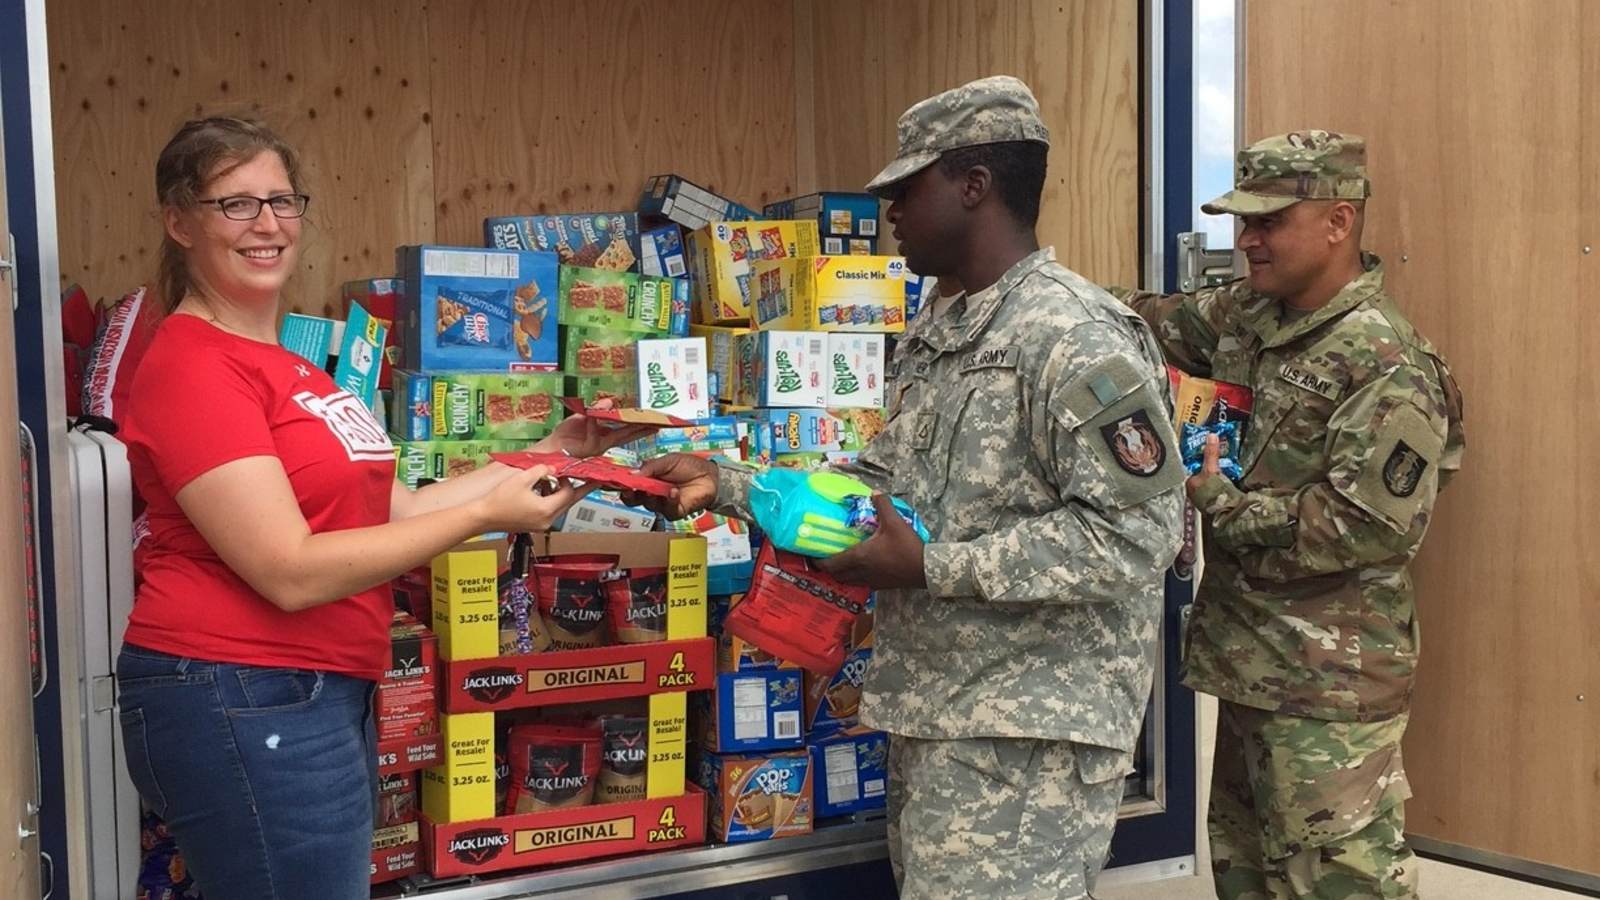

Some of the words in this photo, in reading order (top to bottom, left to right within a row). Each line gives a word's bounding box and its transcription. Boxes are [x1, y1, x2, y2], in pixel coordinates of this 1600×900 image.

[889, 262, 902, 270] 40
[836, 270, 868, 280] Classic
[870, 271, 886, 280] Mix
[458, 291, 508, 319] TRADITIONAL
[641, 281, 657, 327] CRUNCHY
[1300, 374, 1333, 394] ARMY
[452, 383, 469, 434] CRUNCHY
[673, 571, 698, 579] Resale!
[457, 578, 480, 586] Great
[461, 585, 492, 594] Resale!
[670, 599, 688, 608] 3.25
[459, 614, 479, 624] 3.25
[481, 614, 497, 622] oz.
[626, 605, 654, 622] JACK
[669, 652, 685, 672] 4
[384, 669, 403, 678] JACK
[544, 667, 629, 686] ORIGINAL
[463, 676, 490, 690] JACK
[491, 674, 524, 686] LINK'S
[659, 673, 694, 687] PACK
[653, 719, 673, 727] Great
[674, 717, 685, 725] For
[656, 725, 681, 734] Resale!
[452, 740, 472, 748] Great
[475, 739, 490, 747] For
[455, 747, 486, 756] Resale!
[653, 753, 670, 762] 3.25
[671, 752, 684, 760] oz.
[453, 776, 473, 786] 3.25
[476, 775, 490, 784] oz.
[524, 776, 553, 790] JACK
[659, 807, 675, 827] 4
[531, 823, 618, 847] ORIGINAL
[649, 827, 685, 842] PACK
[448, 838, 476, 852] JACK
[477, 834, 510, 847] LINK'S
